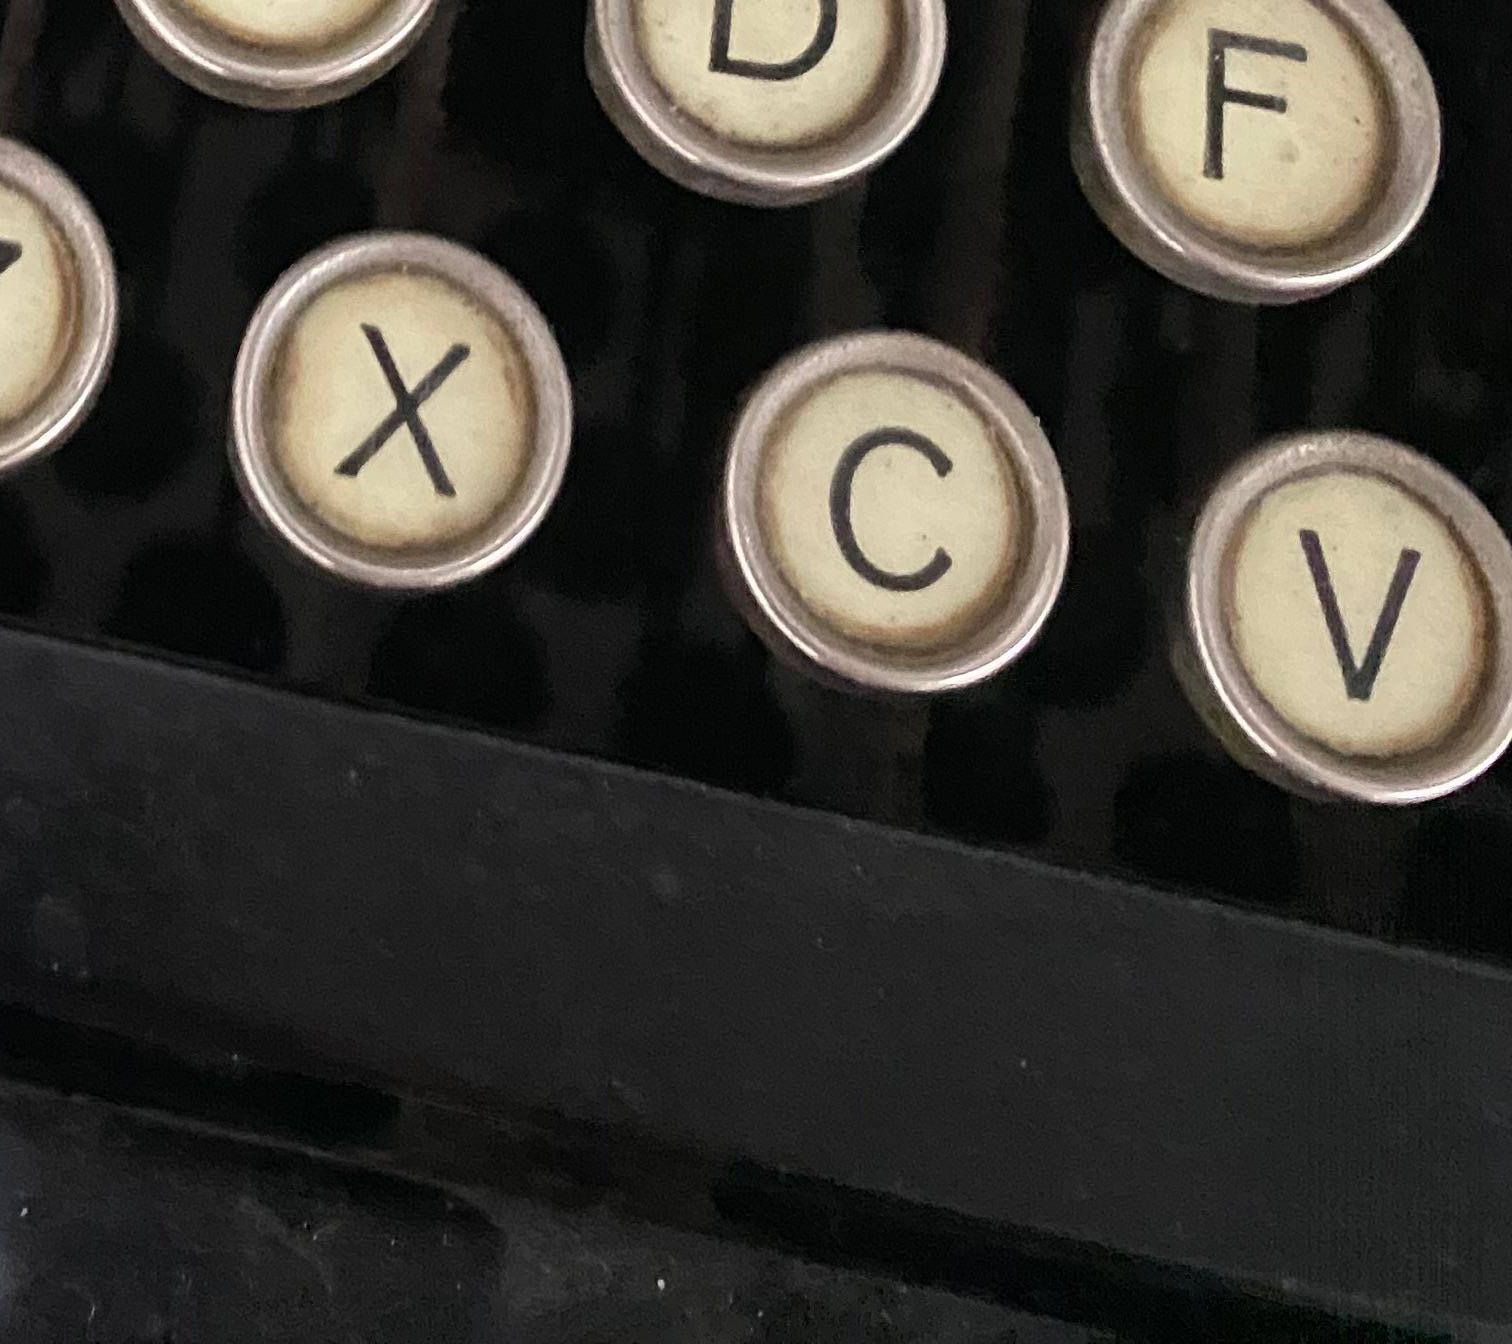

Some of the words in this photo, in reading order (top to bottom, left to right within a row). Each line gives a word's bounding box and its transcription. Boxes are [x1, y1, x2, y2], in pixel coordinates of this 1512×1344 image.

[1202, 27, 1308, 180] F
[334, 322, 470, 497] X
[828, 425, 953, 592] C
[1299, 528, 1422, 702] V
